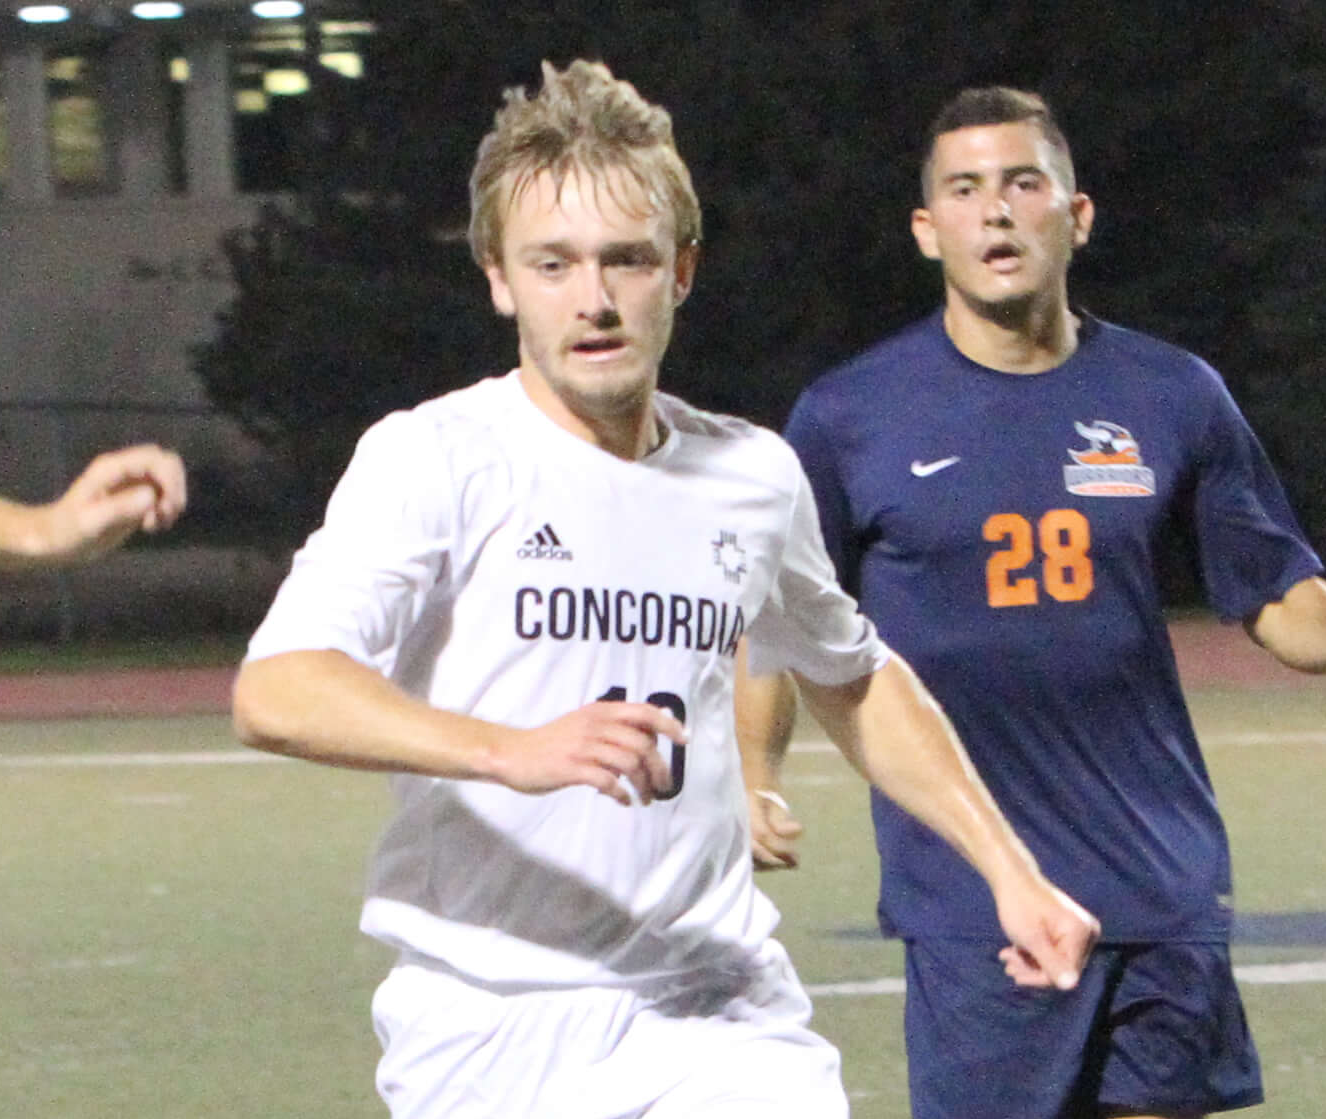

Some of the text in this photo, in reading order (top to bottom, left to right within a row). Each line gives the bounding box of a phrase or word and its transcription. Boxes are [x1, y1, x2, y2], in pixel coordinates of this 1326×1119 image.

[517, 545, 573, 561] adidas
[982, 508, 1094, 608] 28
[514, 587, 745, 658] CONCORDIA
